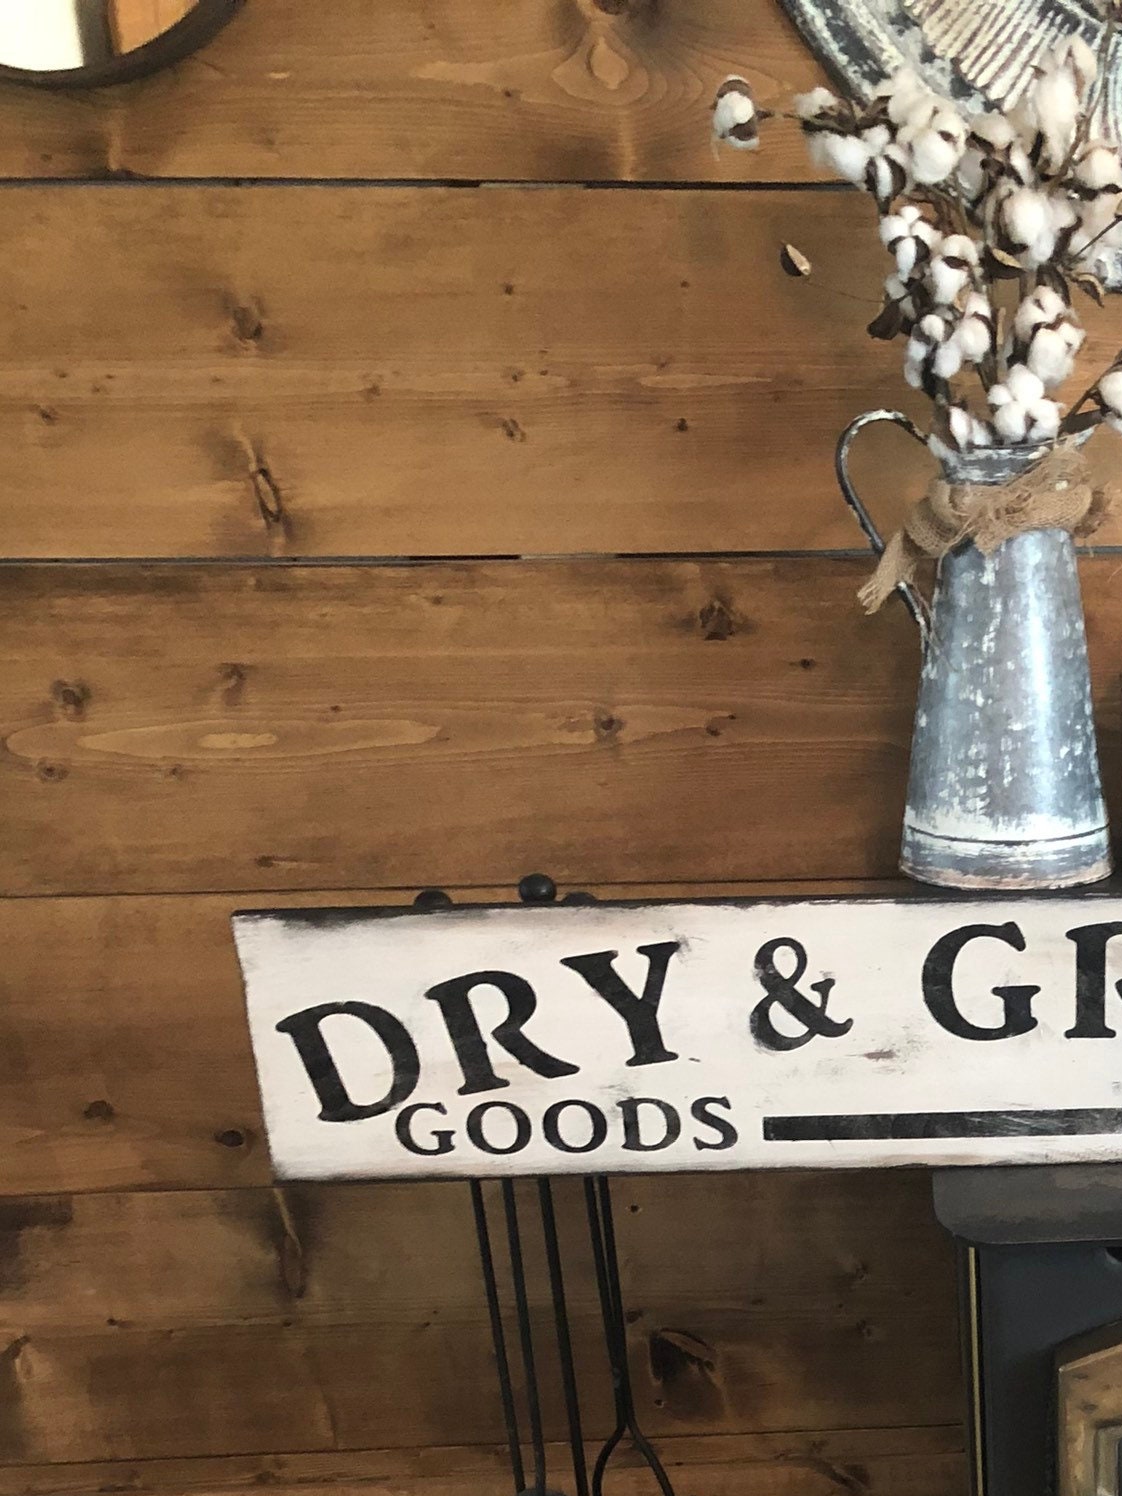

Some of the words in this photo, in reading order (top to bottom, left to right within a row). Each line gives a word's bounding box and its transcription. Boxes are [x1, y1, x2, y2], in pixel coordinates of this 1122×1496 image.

[276, 941, 680, 1122] DRY
[749, 936, 854, 1052] &
[394, 1096, 740, 1157] GOODS
